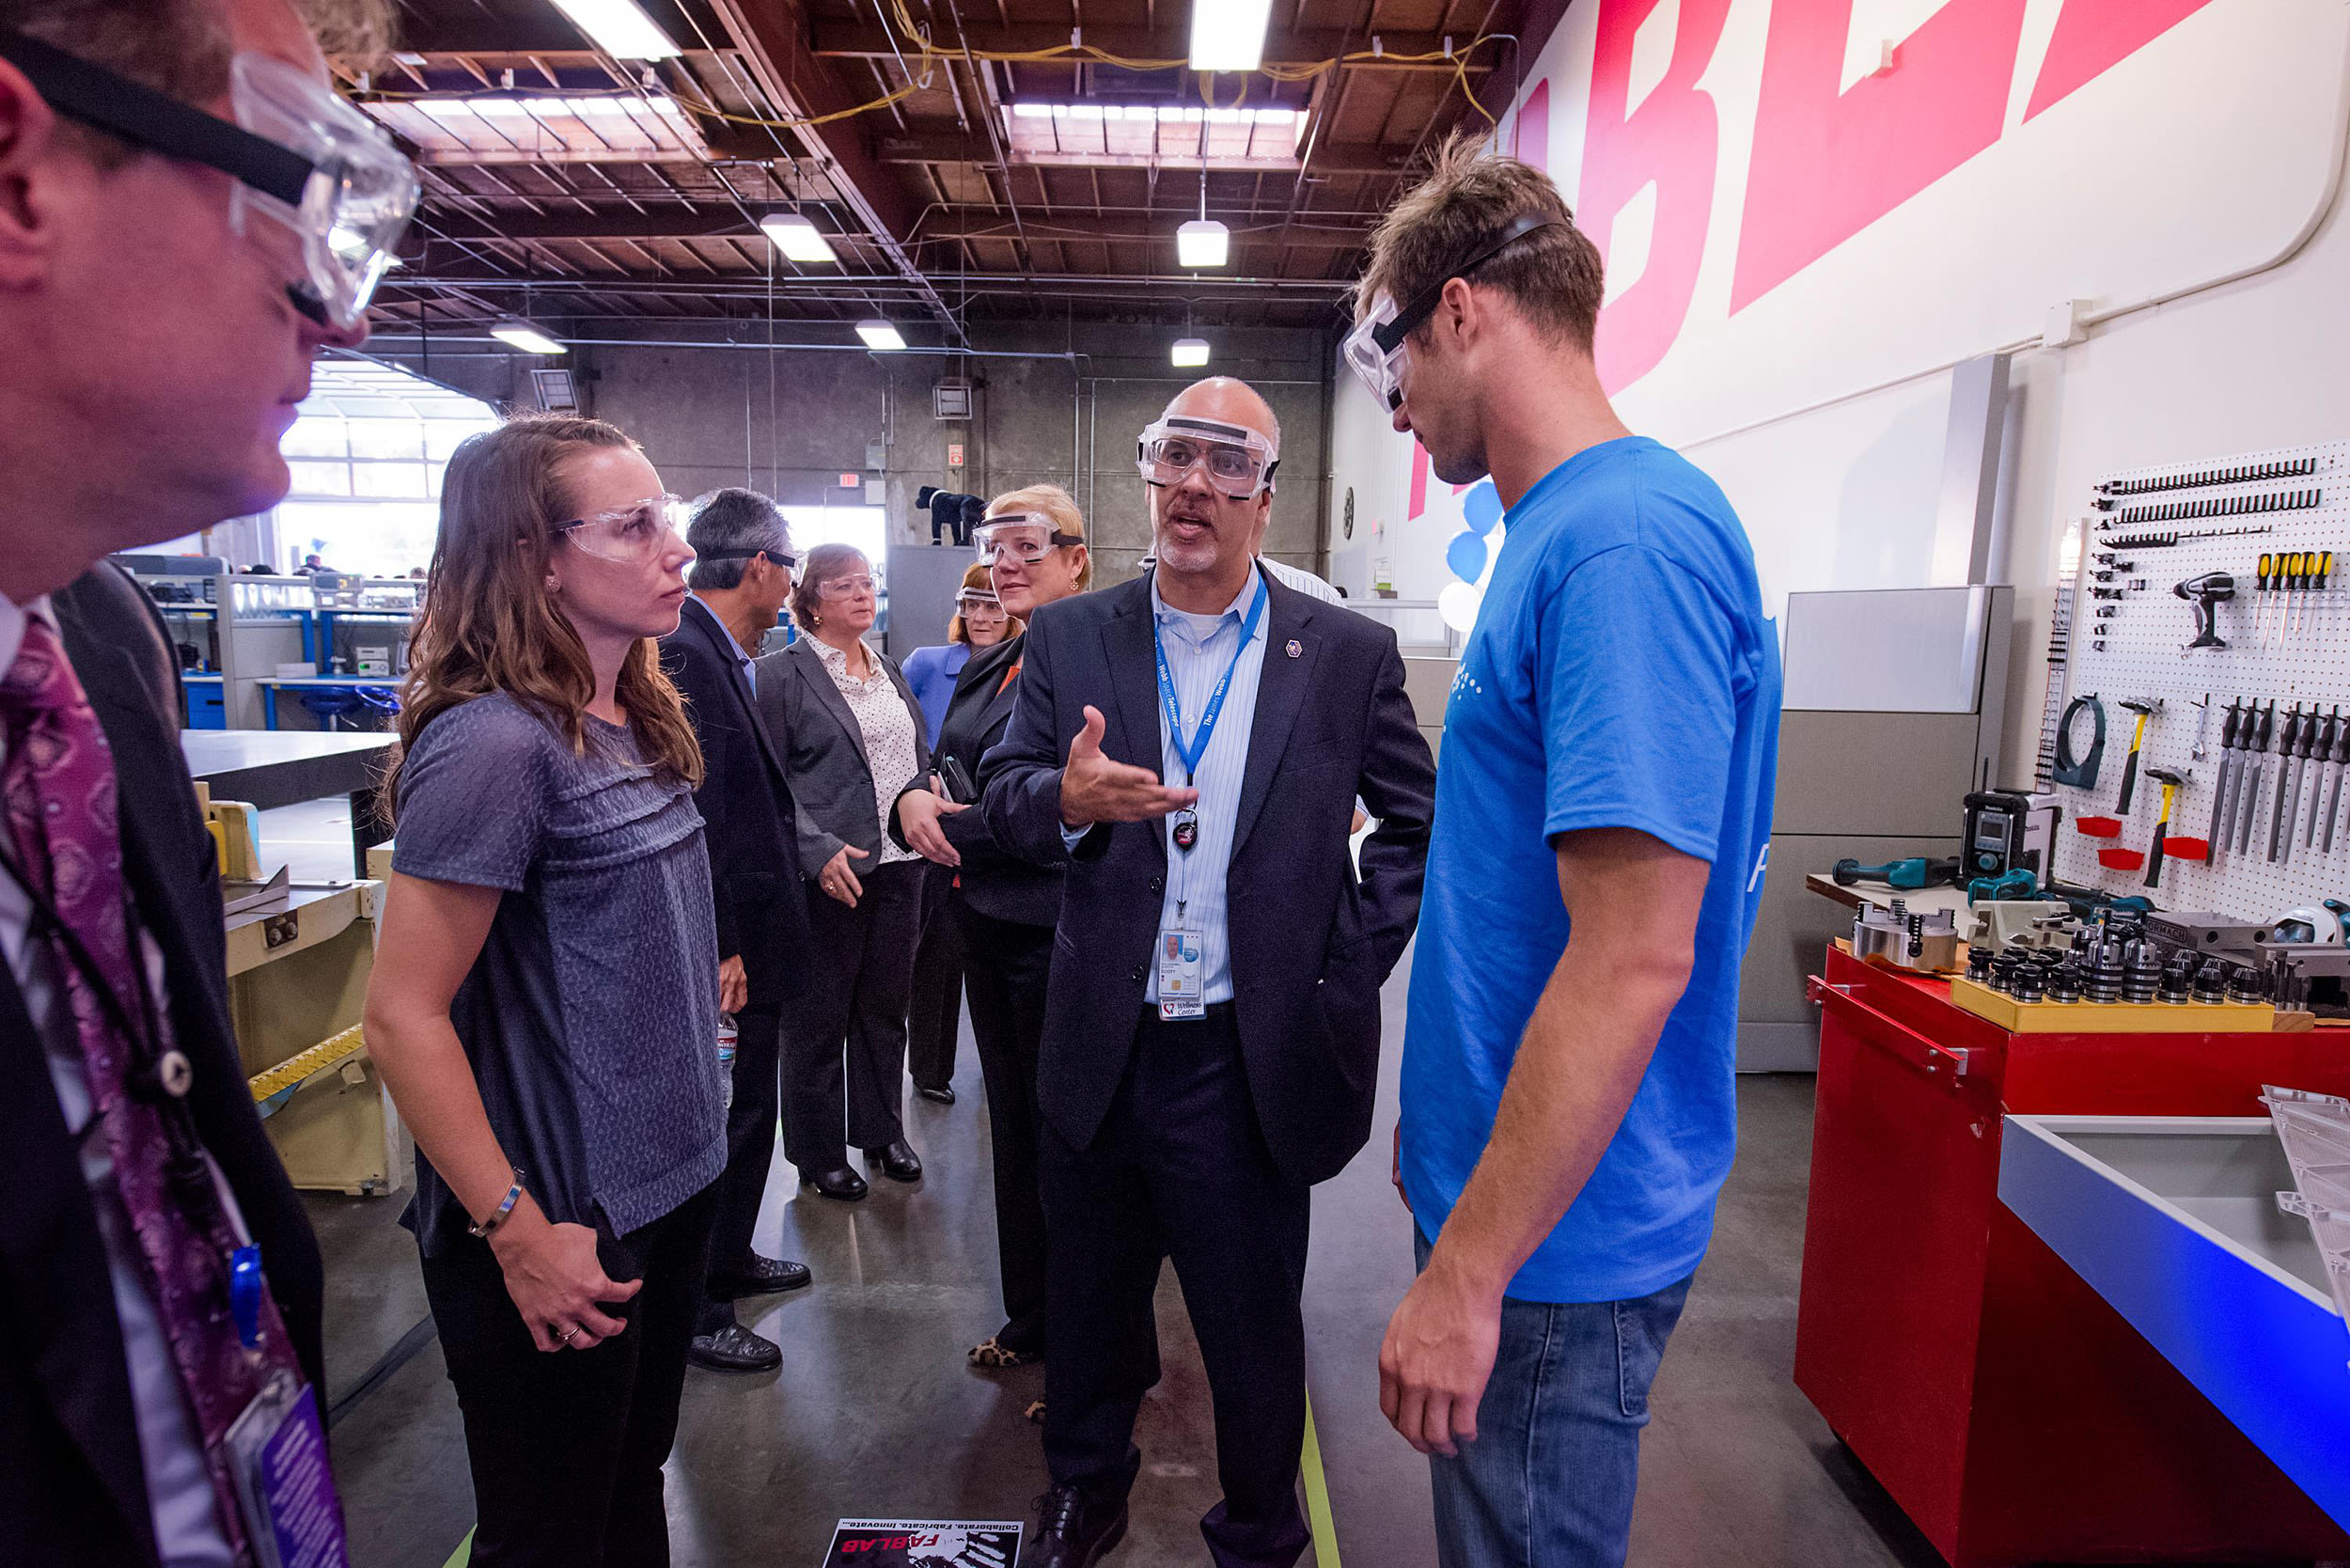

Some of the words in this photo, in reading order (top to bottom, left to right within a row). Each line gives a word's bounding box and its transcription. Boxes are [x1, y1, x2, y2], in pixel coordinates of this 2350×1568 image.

[1159, 664, 1168, 682] Webb
[1167, 697, 1179, 728] Telescope
[1214, 678, 1227, 697] Webb
[1211, 697, 1221, 715] James
[1203, 713, 1214, 727] The
[2148, 922, 2186, 940] ORMACH
[1177, 999, 1202, 1010] Wellness
[901, 1522, 952, 1530] Fabricate.
[955, 1523, 1019, 1531] Collaborate.
[841, 1533, 940, 1553] FABLAB
